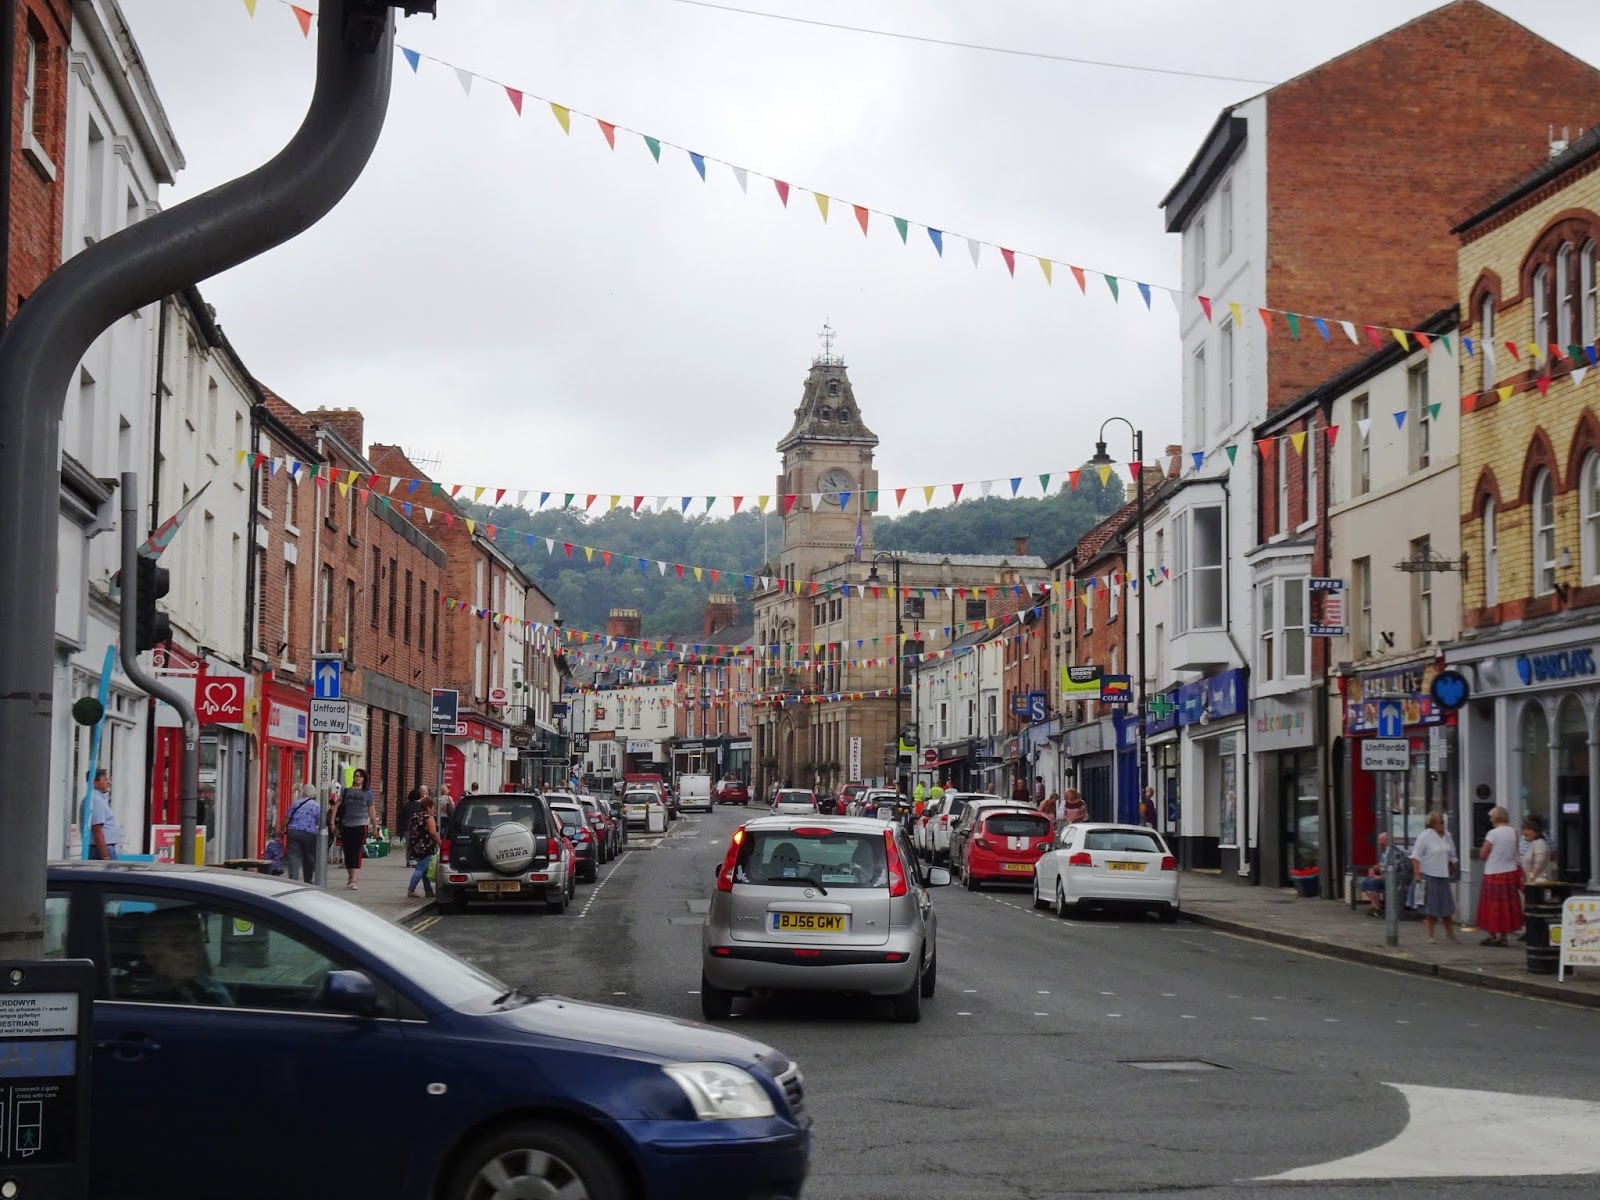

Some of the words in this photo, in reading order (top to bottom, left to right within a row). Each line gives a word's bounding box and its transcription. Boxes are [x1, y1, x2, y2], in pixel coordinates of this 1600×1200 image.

[1532, 647, 1596, 682] BARCLAYS
[313, 704, 346, 714] Unffordd
[313, 718, 328, 728] One
[330, 718, 345, 730] Way
[1365, 744, 1406, 752] Unffordd
[1365, 758, 1383, 766] One
[1386, 758, 1406, 768] Way
[495, 849, 529, 860] VITARA
[782, 912, 814, 928] BJ56
[818, 914, 842, 929] GMY
